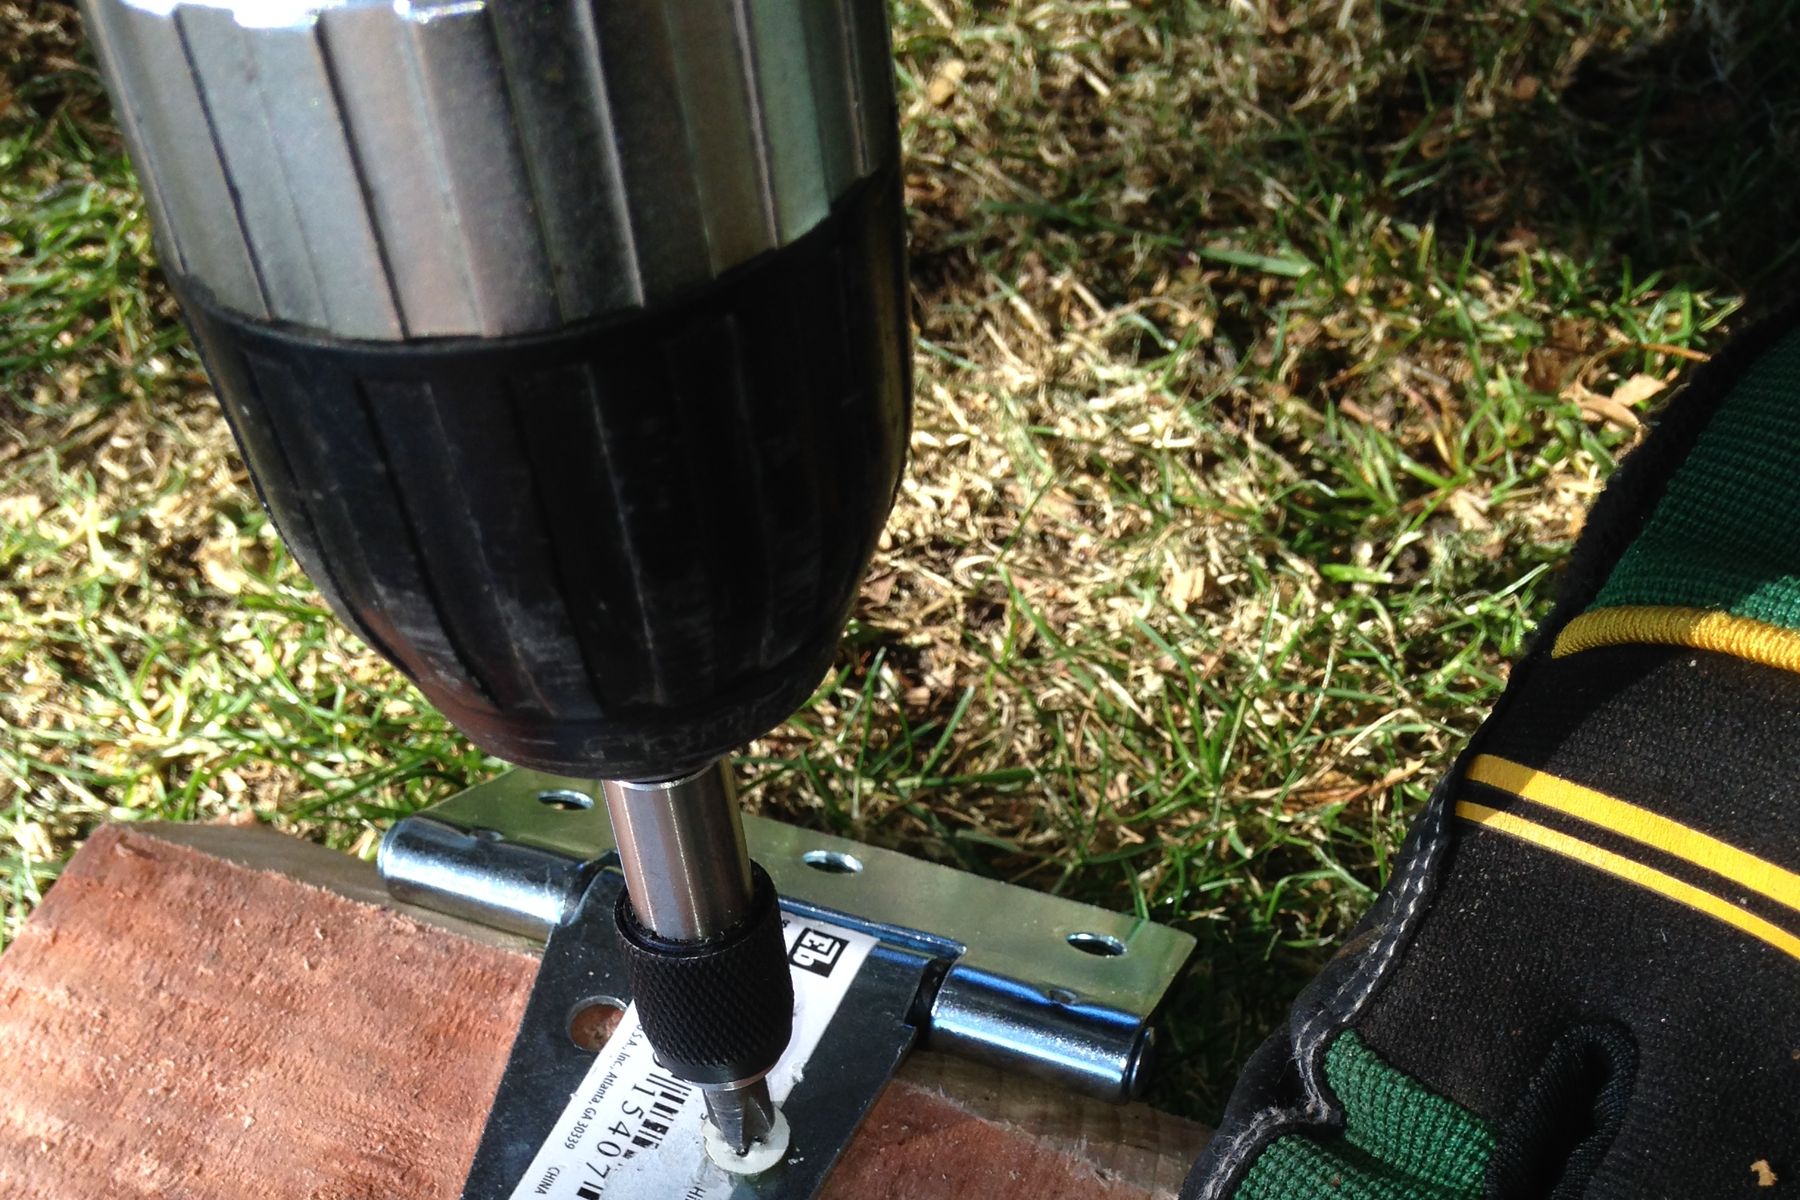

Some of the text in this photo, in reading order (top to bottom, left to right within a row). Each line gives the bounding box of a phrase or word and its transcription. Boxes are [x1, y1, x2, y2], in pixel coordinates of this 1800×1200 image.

[588, 1071, 617, 1105] Atlanta,
[581, 1107, 596, 1120] GA
[564, 1121, 587, 1150] 30339
[534, 1167, 560, 1195] CHINA
